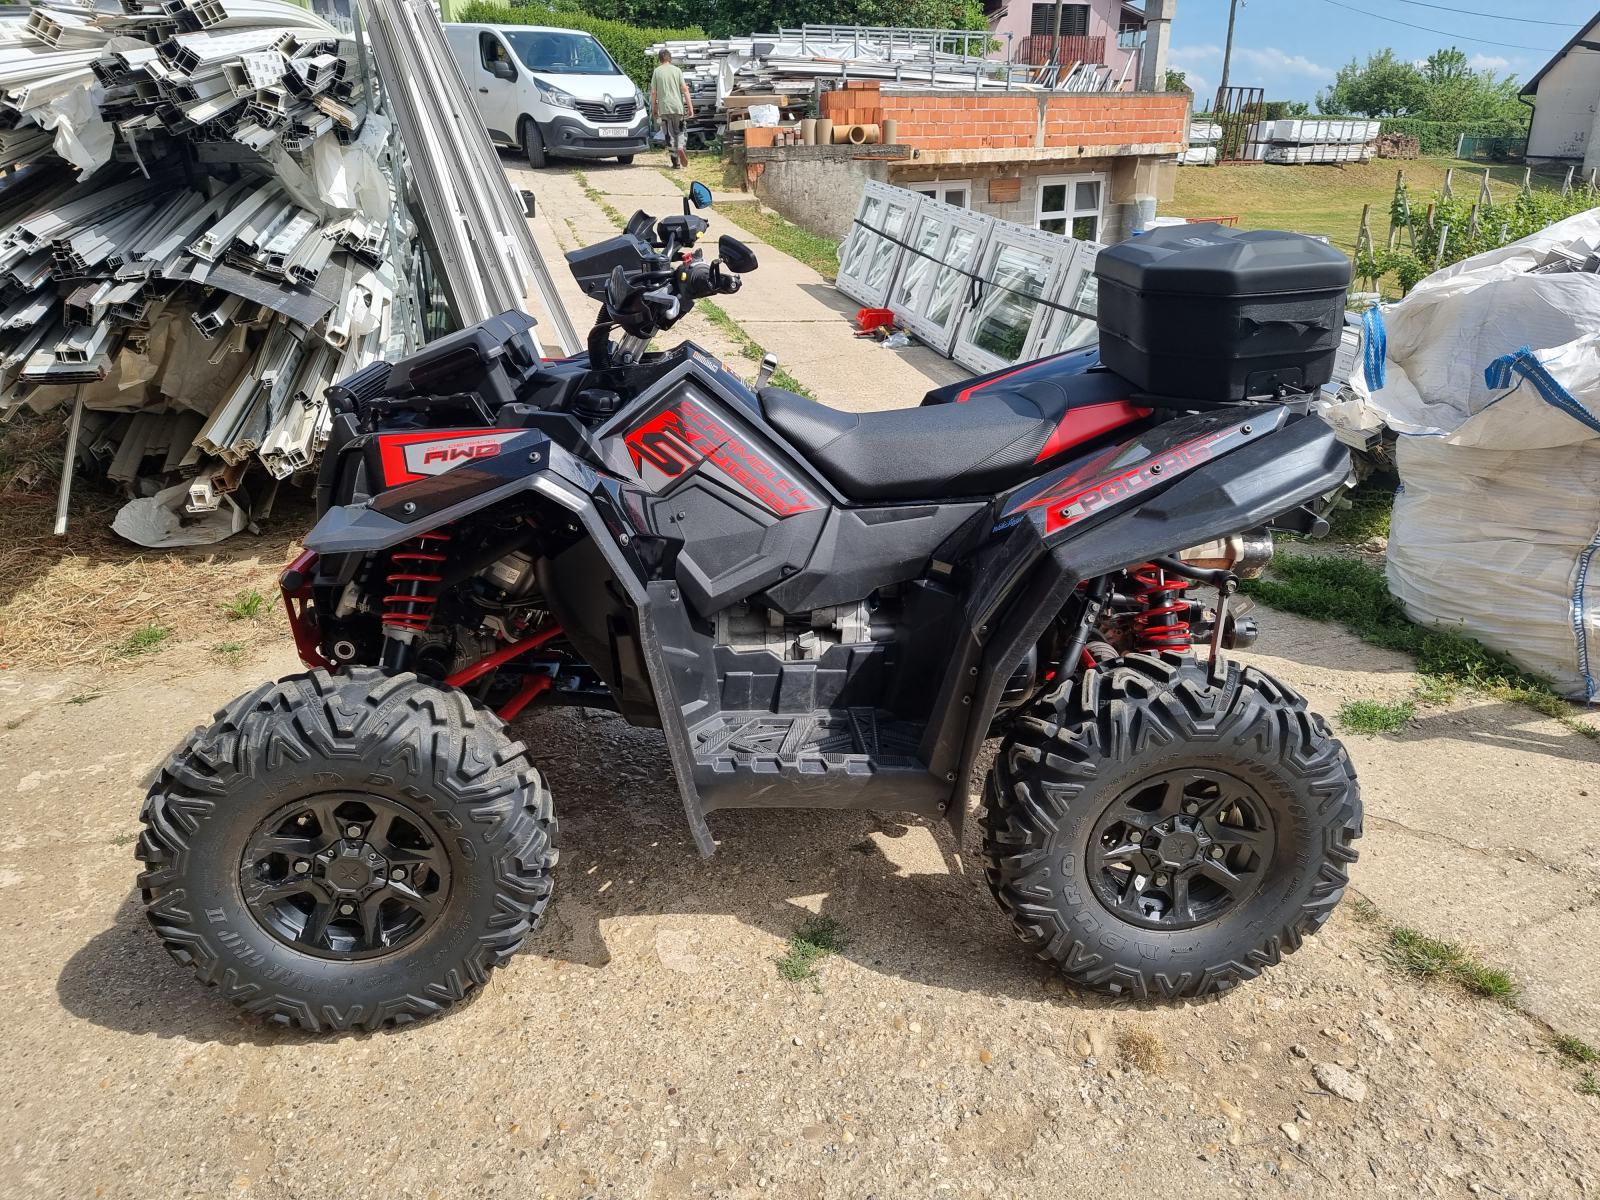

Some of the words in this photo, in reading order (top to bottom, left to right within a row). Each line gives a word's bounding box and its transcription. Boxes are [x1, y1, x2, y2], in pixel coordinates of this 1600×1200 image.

[423, 443, 501, 464] AWD
[677, 400, 808, 503] SCRAMBLER
[1077, 446, 1213, 513] POLARIS
[1061, 852, 1128, 952] DURO
